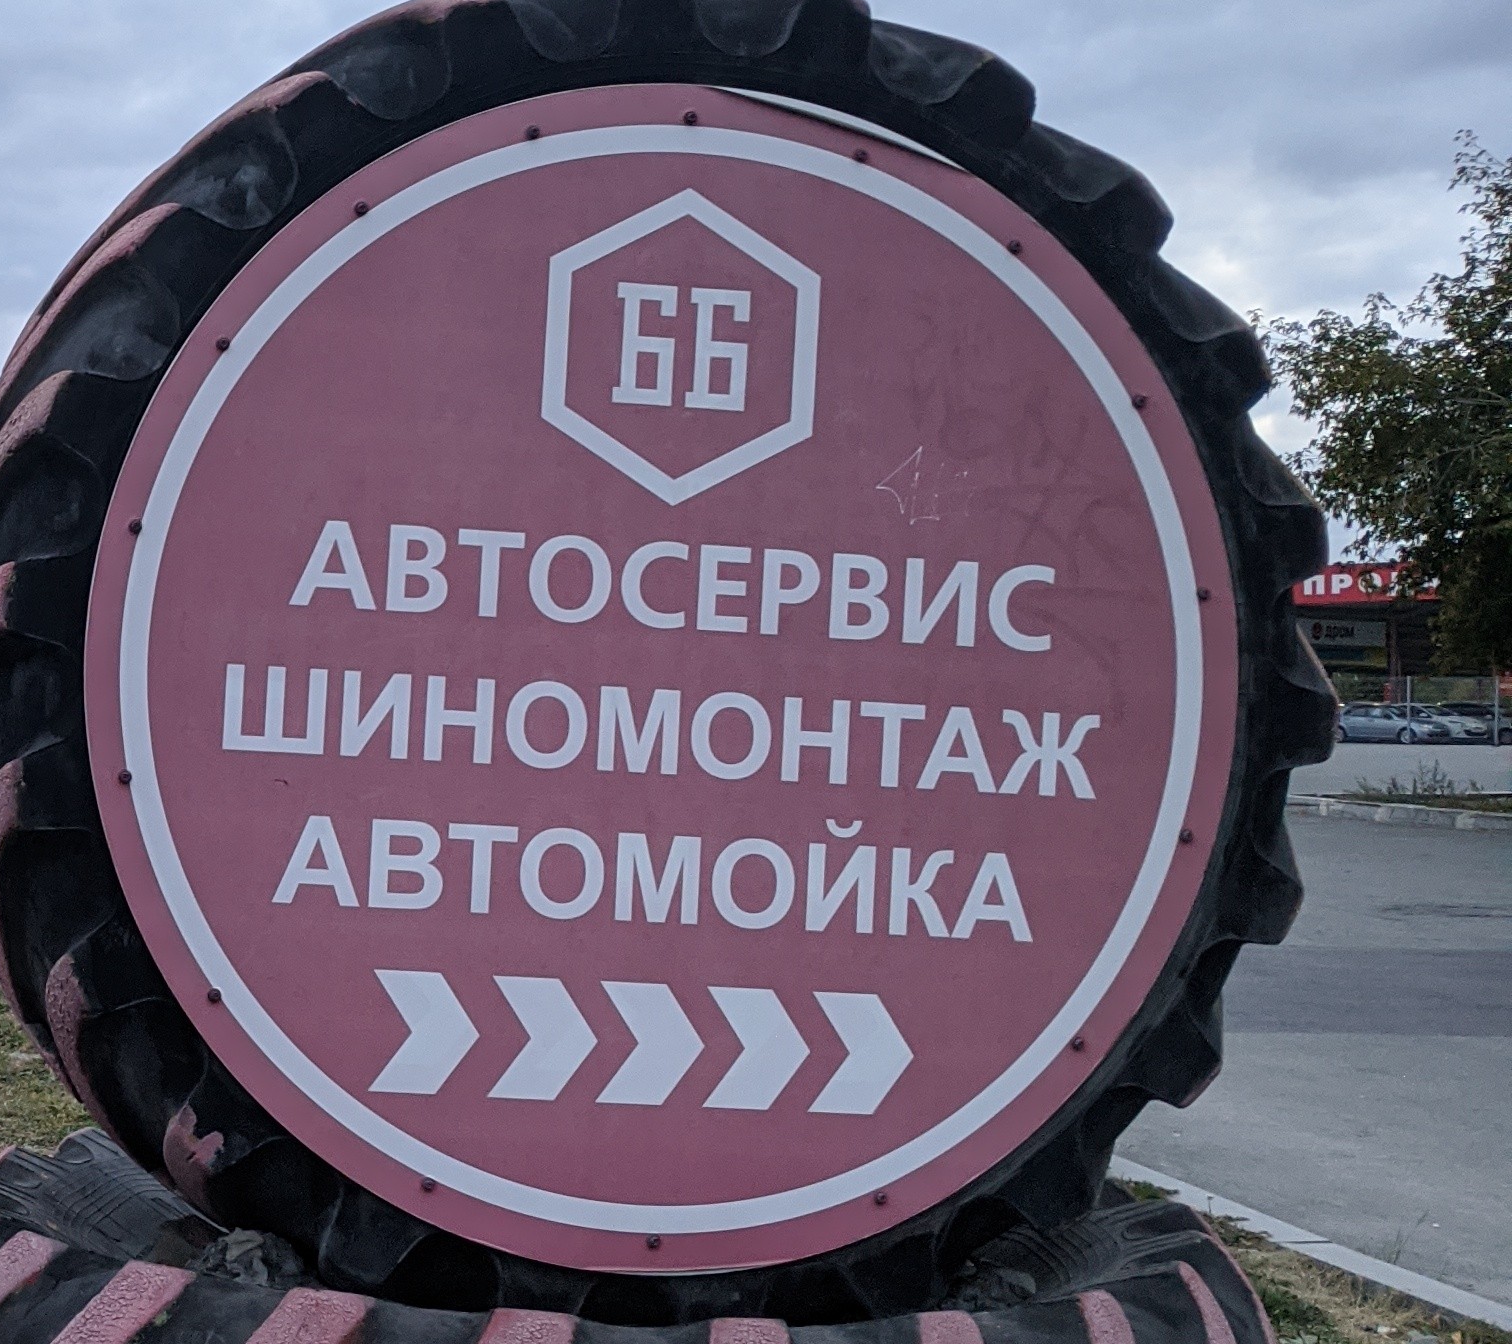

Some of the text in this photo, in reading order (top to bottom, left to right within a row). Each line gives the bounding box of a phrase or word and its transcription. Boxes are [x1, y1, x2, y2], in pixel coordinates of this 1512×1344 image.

[289, 521, 1056, 652] АВТОСЕРВИС
[222, 664, 1101, 800] ШИНОМОНТАЖ
[272, 815, 1034, 943] АВТОМОЙКА
